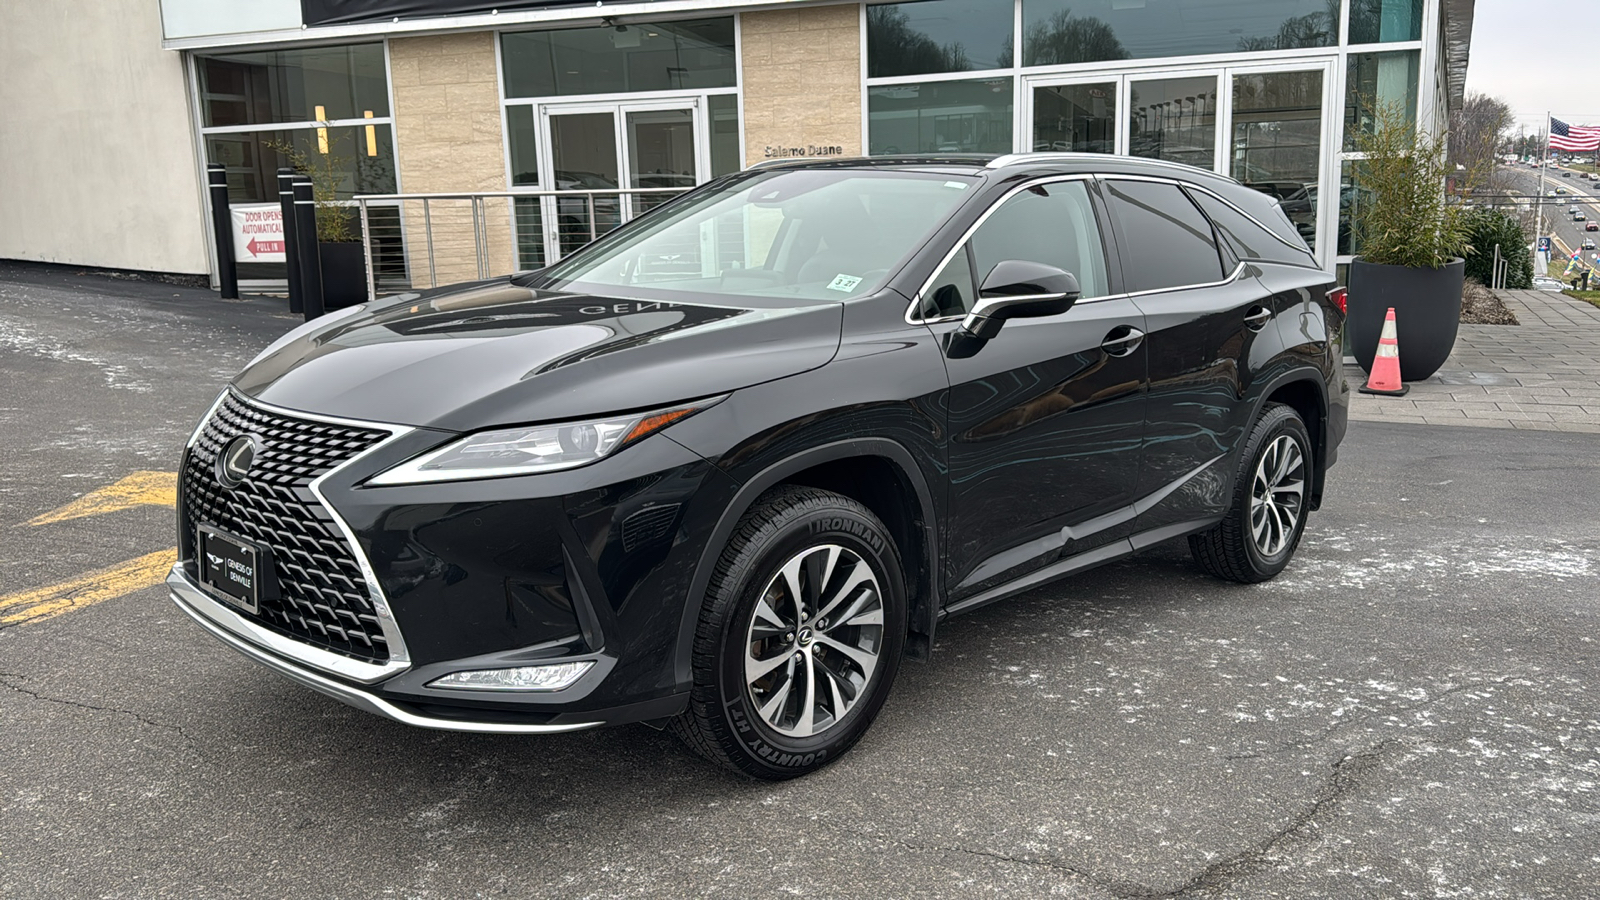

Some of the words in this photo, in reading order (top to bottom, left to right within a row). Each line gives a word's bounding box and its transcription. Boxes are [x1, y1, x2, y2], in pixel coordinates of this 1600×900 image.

[808, 145, 842, 156] Duane
[245, 212, 262, 222] DOOR
[263, 210, 282, 221] OPENS
[242, 223, 282, 234] AUTOMATICAL
[256, 242, 271, 252] PULL
[271, 242, 279, 251] IN
[816, 518, 881, 550] IRONMAN
[227, 558, 246, 573] GENESIS
[245, 566, 253, 576] OF
[230, 571, 251, 588] DENVILLE
[731, 709, 750, 733] HT
[748, 739, 828, 767] COUNTRY
